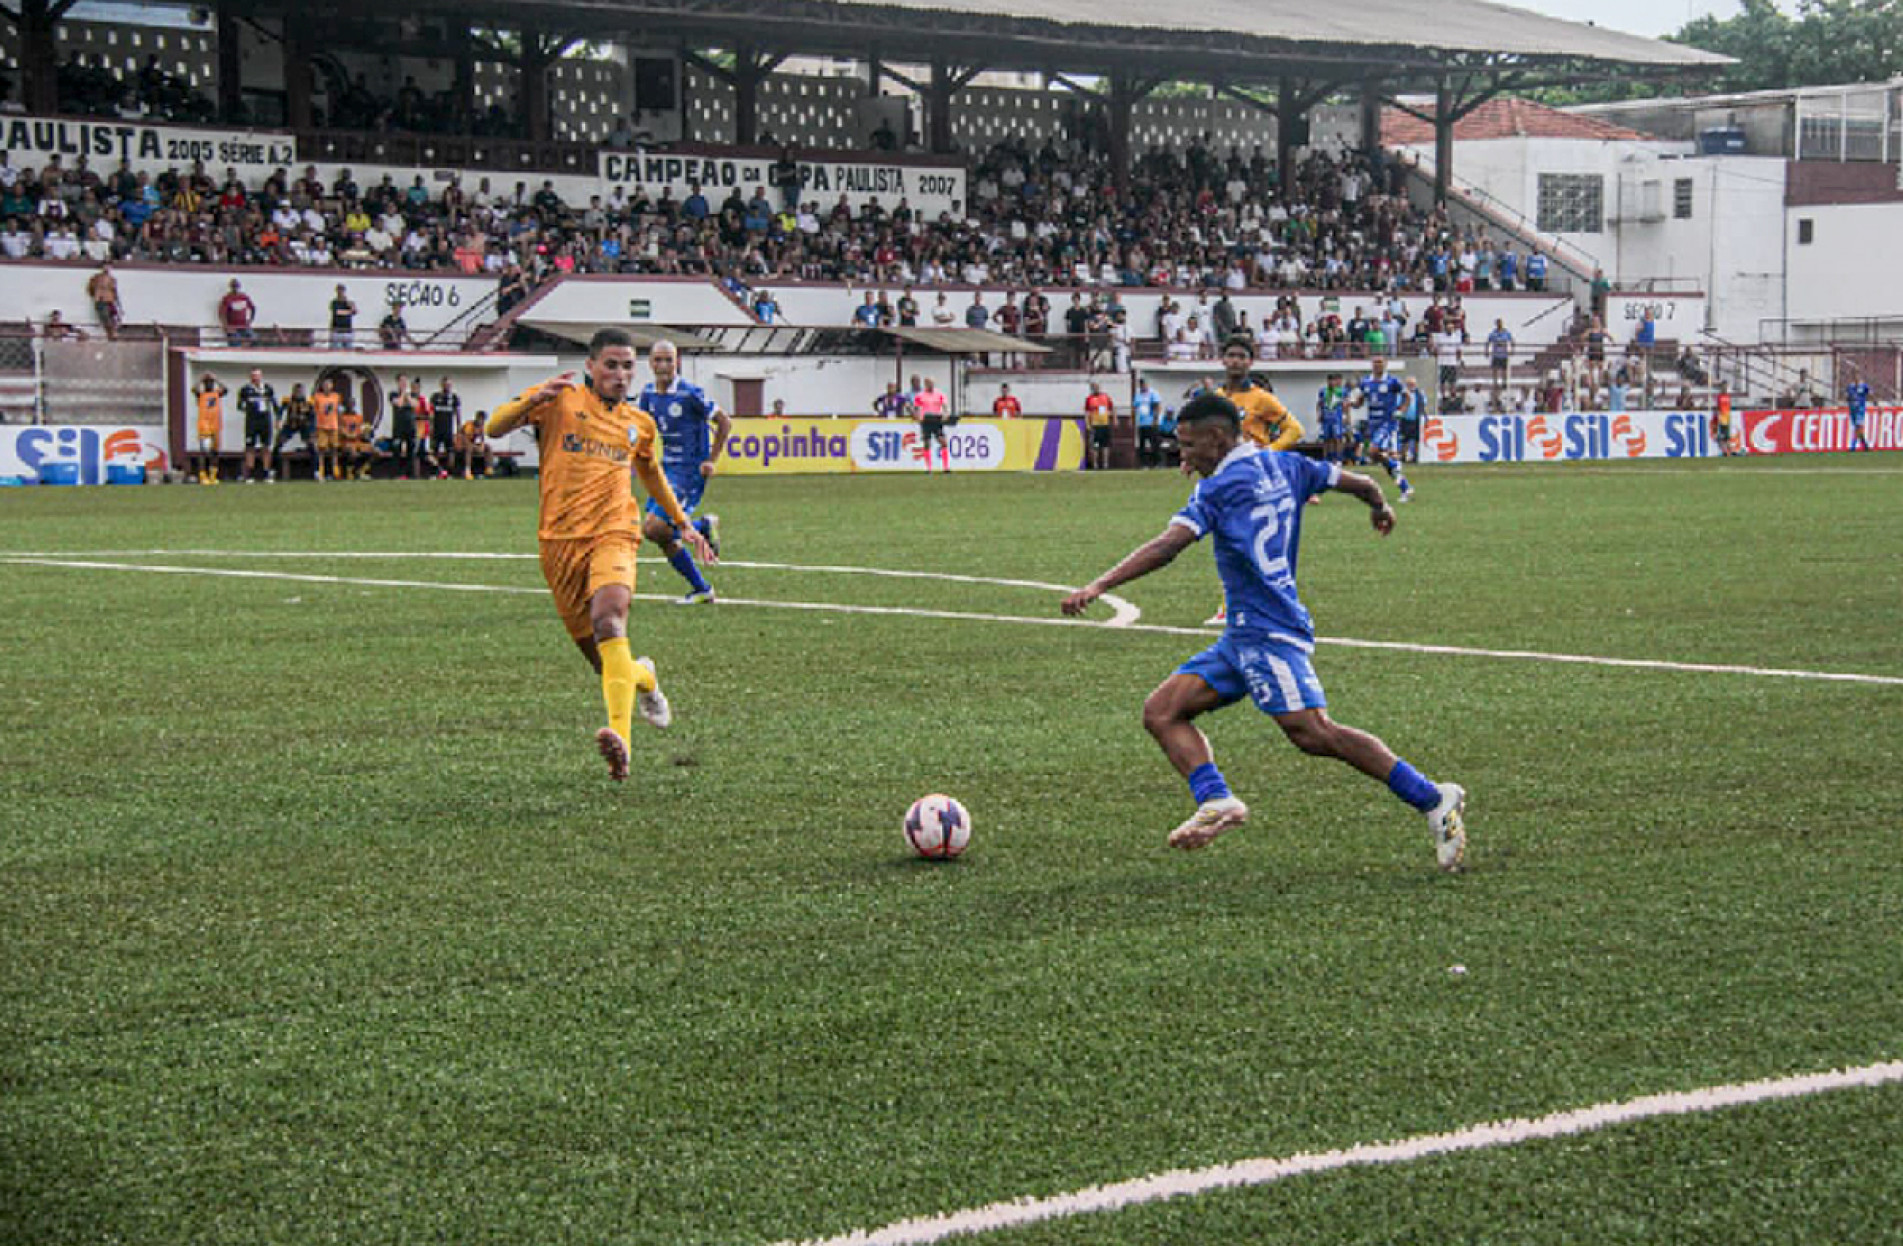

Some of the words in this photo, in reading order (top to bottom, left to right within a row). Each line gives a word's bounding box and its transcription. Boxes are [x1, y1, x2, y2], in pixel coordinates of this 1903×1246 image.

[0, 120, 162, 163] AULISTA
[167, 139, 213, 161] 2005
[768, 162, 829, 192] CPA
[836, 164, 905, 194] PAULISTA
[919, 175, 956, 195] 2007
[448, 285, 459, 307] 6
[1667, 301, 1676, 320] 7
[727, 424, 847, 466] copinha
[867, 431, 900, 461] Sil
[937, 434, 990, 461] 026
[1479, 414, 1524, 462] Sil
[1565, 414, 1609, 458] Sil
[1664, 414, 1708, 458] Sil
[1791, 411, 1903, 450] CENTURO
[16, 428, 99, 485] Sil
